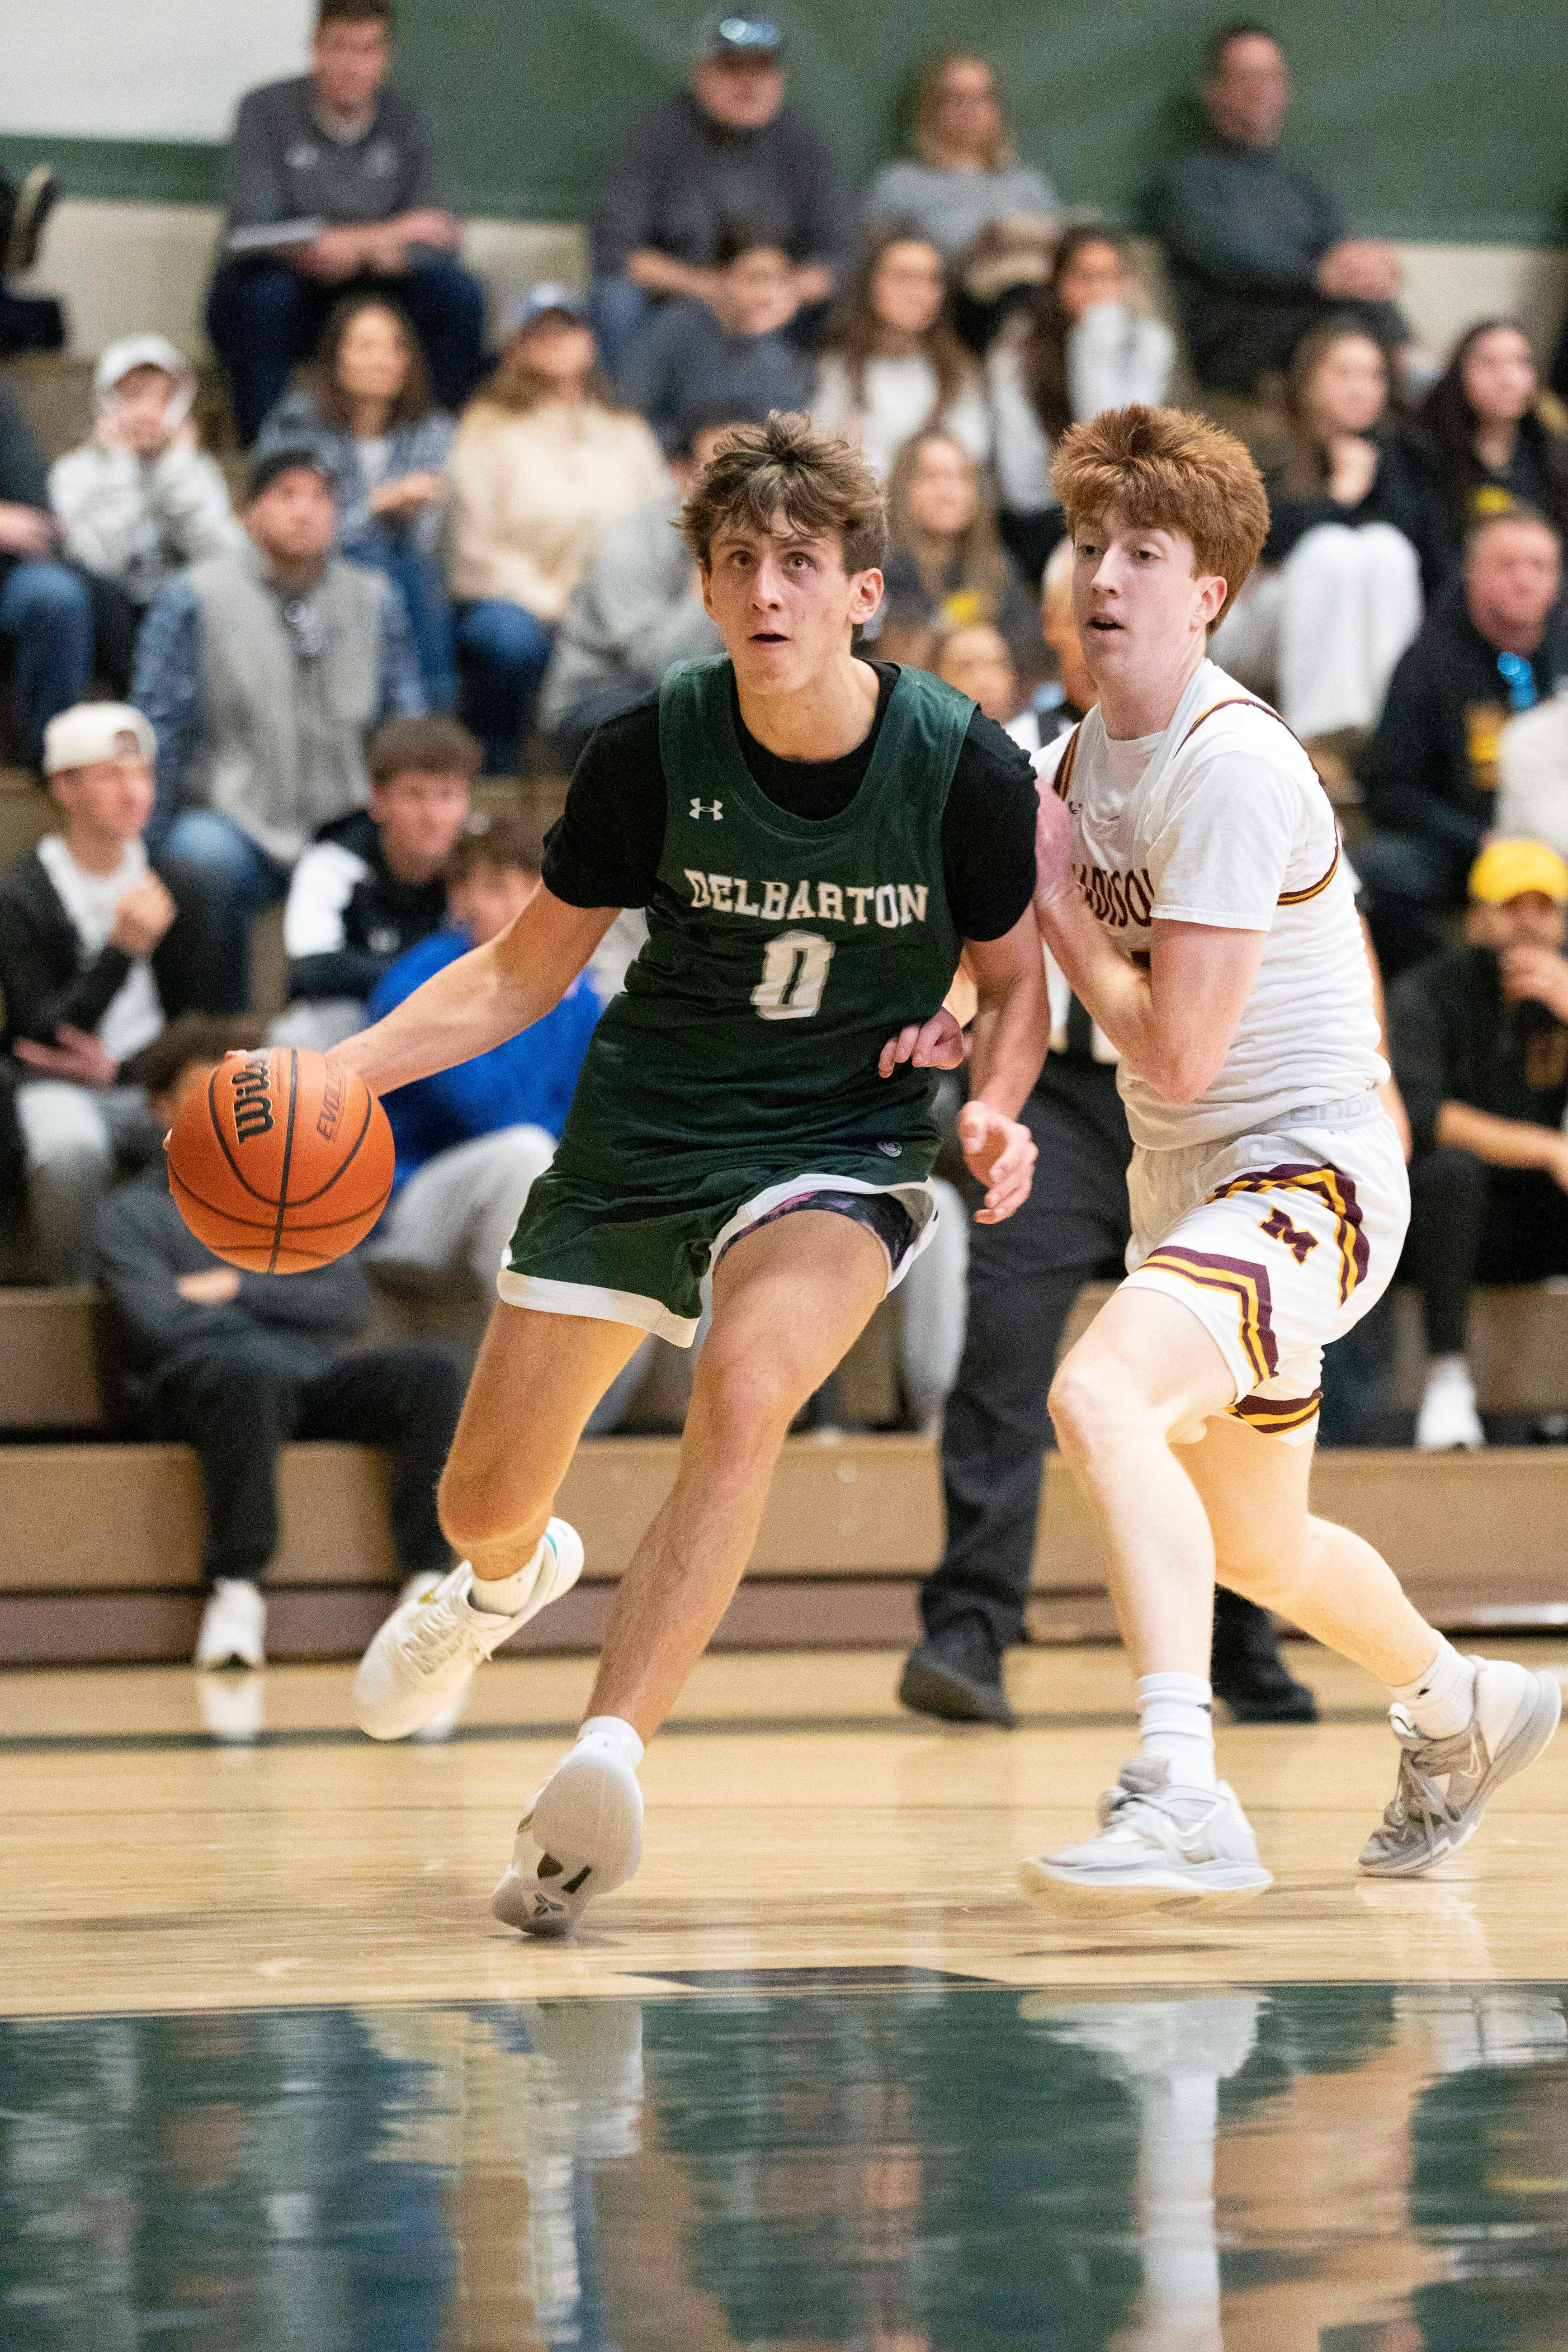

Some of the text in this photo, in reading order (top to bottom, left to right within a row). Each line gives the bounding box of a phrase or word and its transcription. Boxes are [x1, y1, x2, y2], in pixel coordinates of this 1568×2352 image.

[683, 868, 929, 929] DELBARTON
[750, 929, 835, 1021] 0
[1258, 1205, 1320, 1267] M
